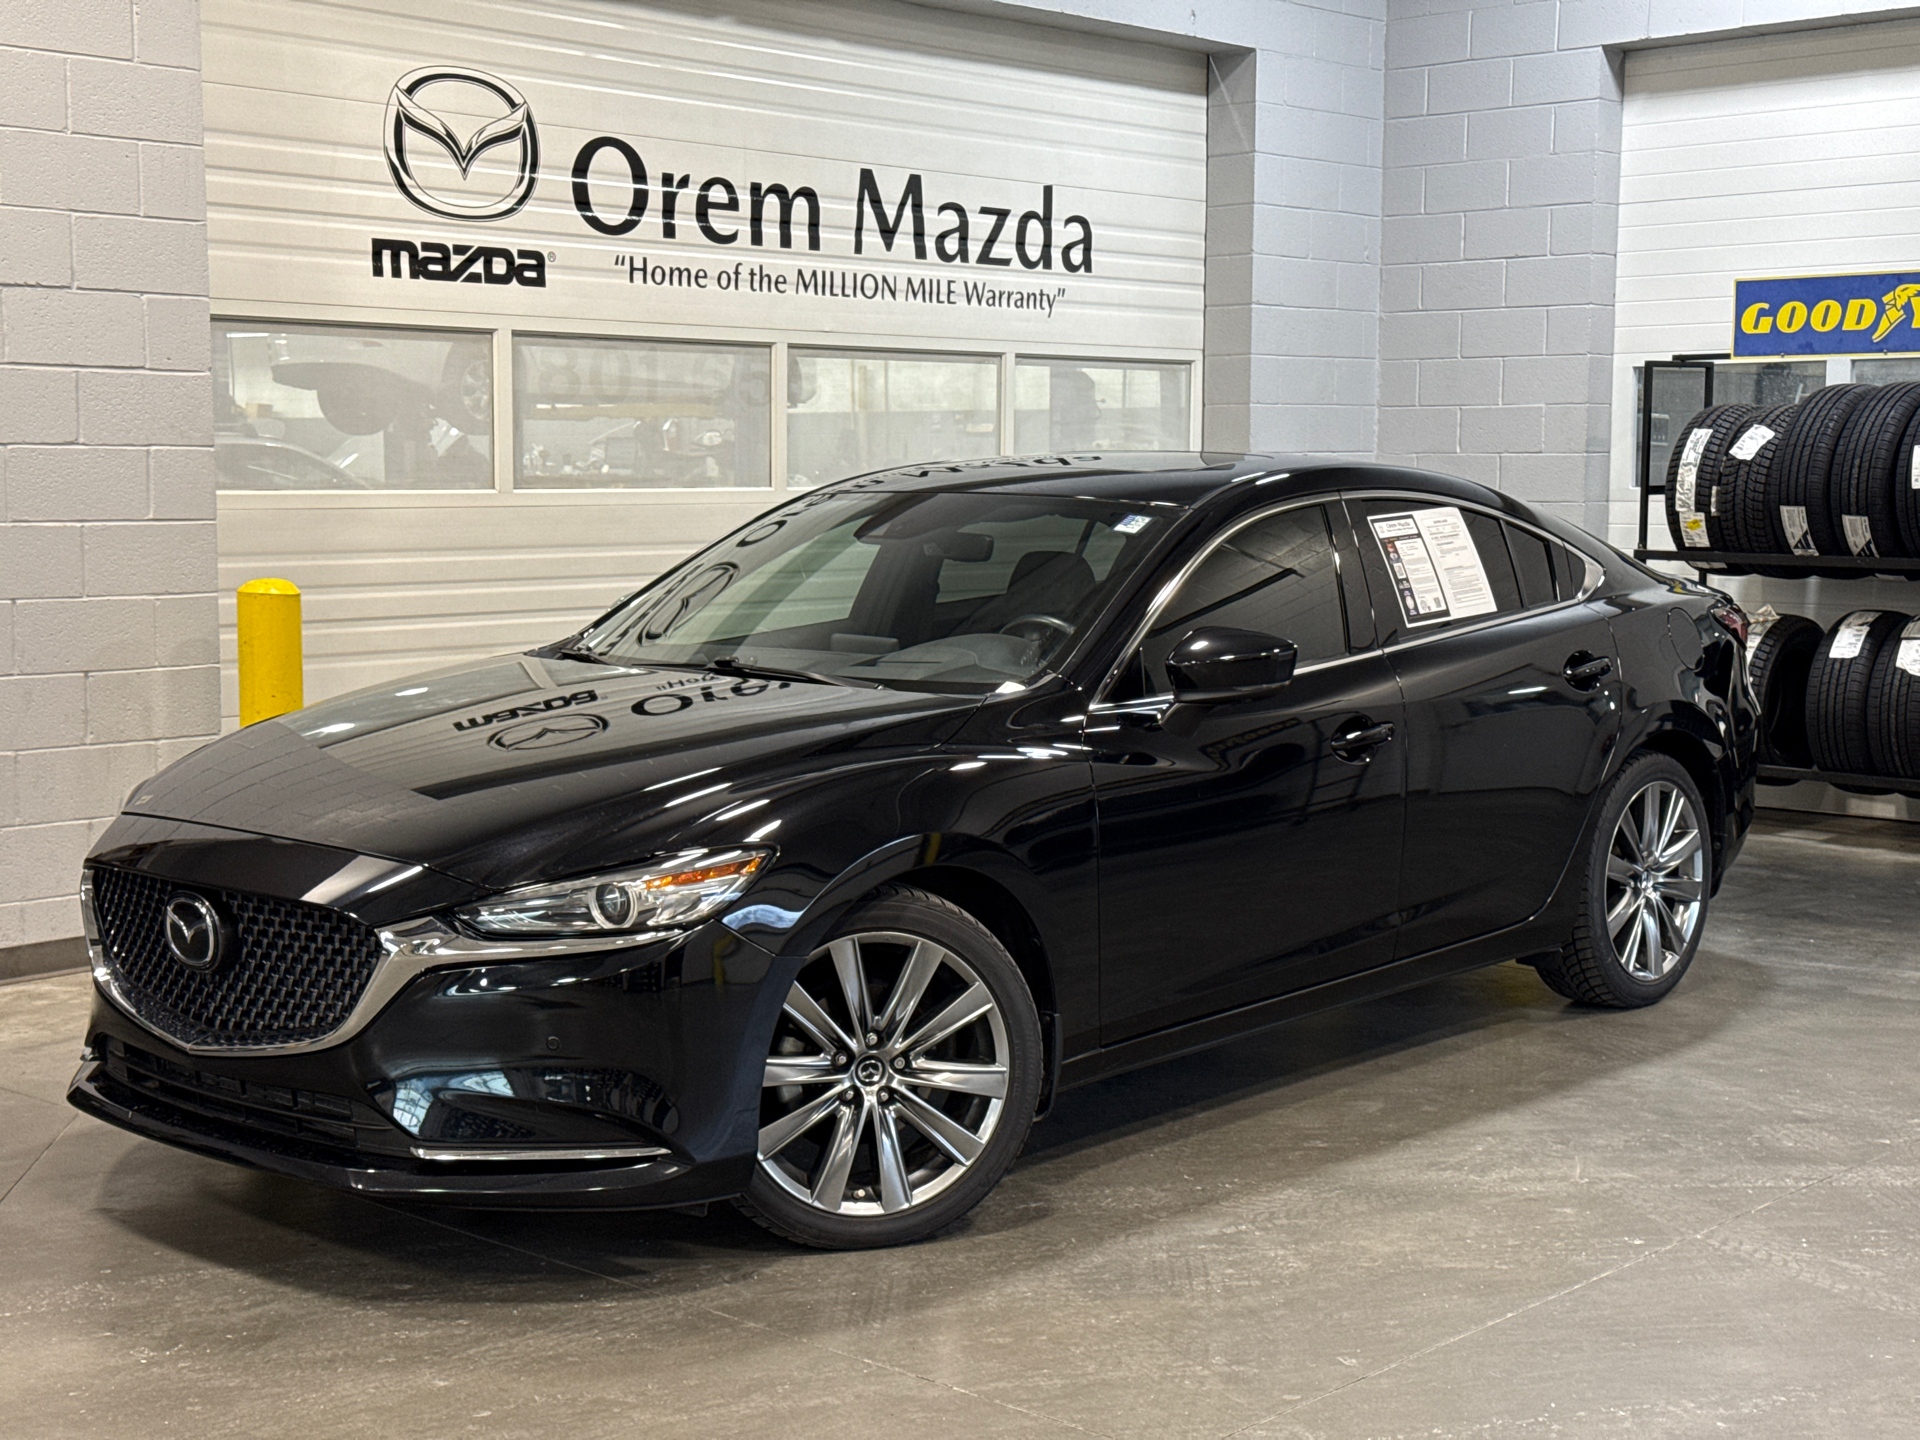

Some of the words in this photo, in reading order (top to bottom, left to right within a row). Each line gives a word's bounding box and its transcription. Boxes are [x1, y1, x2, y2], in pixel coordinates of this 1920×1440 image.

[571, 136, 821, 251] Orem
[854, 168, 1093, 274] Mazda
[717, 262, 743, 291] of
[748, 264, 787, 294] the
[796, 268, 898, 301] MILLION
[906, 277, 957, 305] MILE
